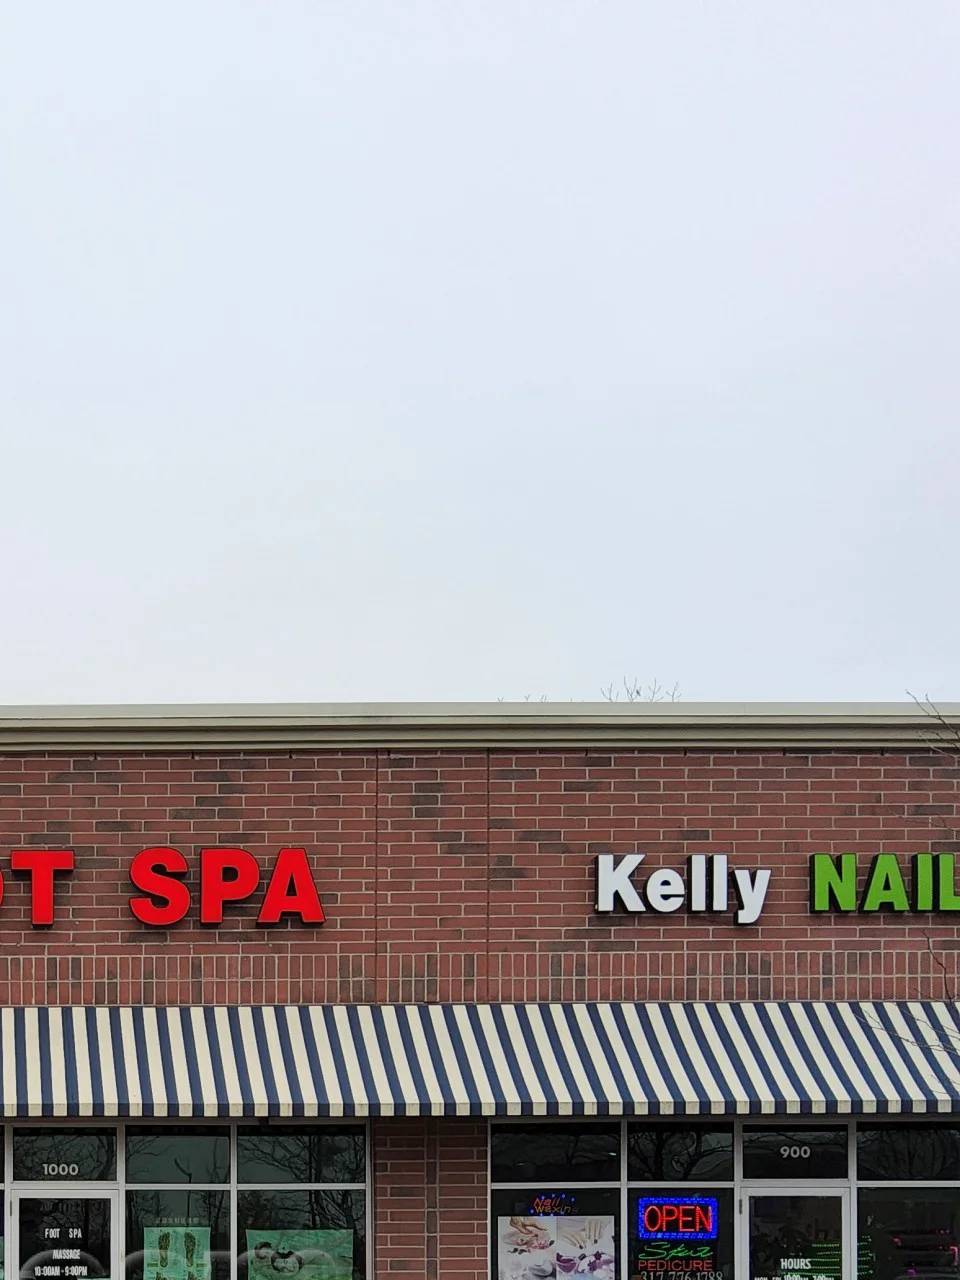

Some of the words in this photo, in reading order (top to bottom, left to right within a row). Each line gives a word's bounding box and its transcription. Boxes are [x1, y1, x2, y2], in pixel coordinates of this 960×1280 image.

[128, 848, 324, 926] SPA
[595, 853, 770, 924] Kelly
[780, 1146, 811, 1158] 900
[43, 1163, 79, 1175] 1000
[644, 1205, 713, 1232] OPEN
[45, 1228, 60, 1238] FOOT
[69, 1228, 82, 1238] SPA
[52, 1249, 81, 1259] MASSAGE
[638, 1260, 713, 1271] PEDICURE
[780, 1258, 812, 1270] HOURS
